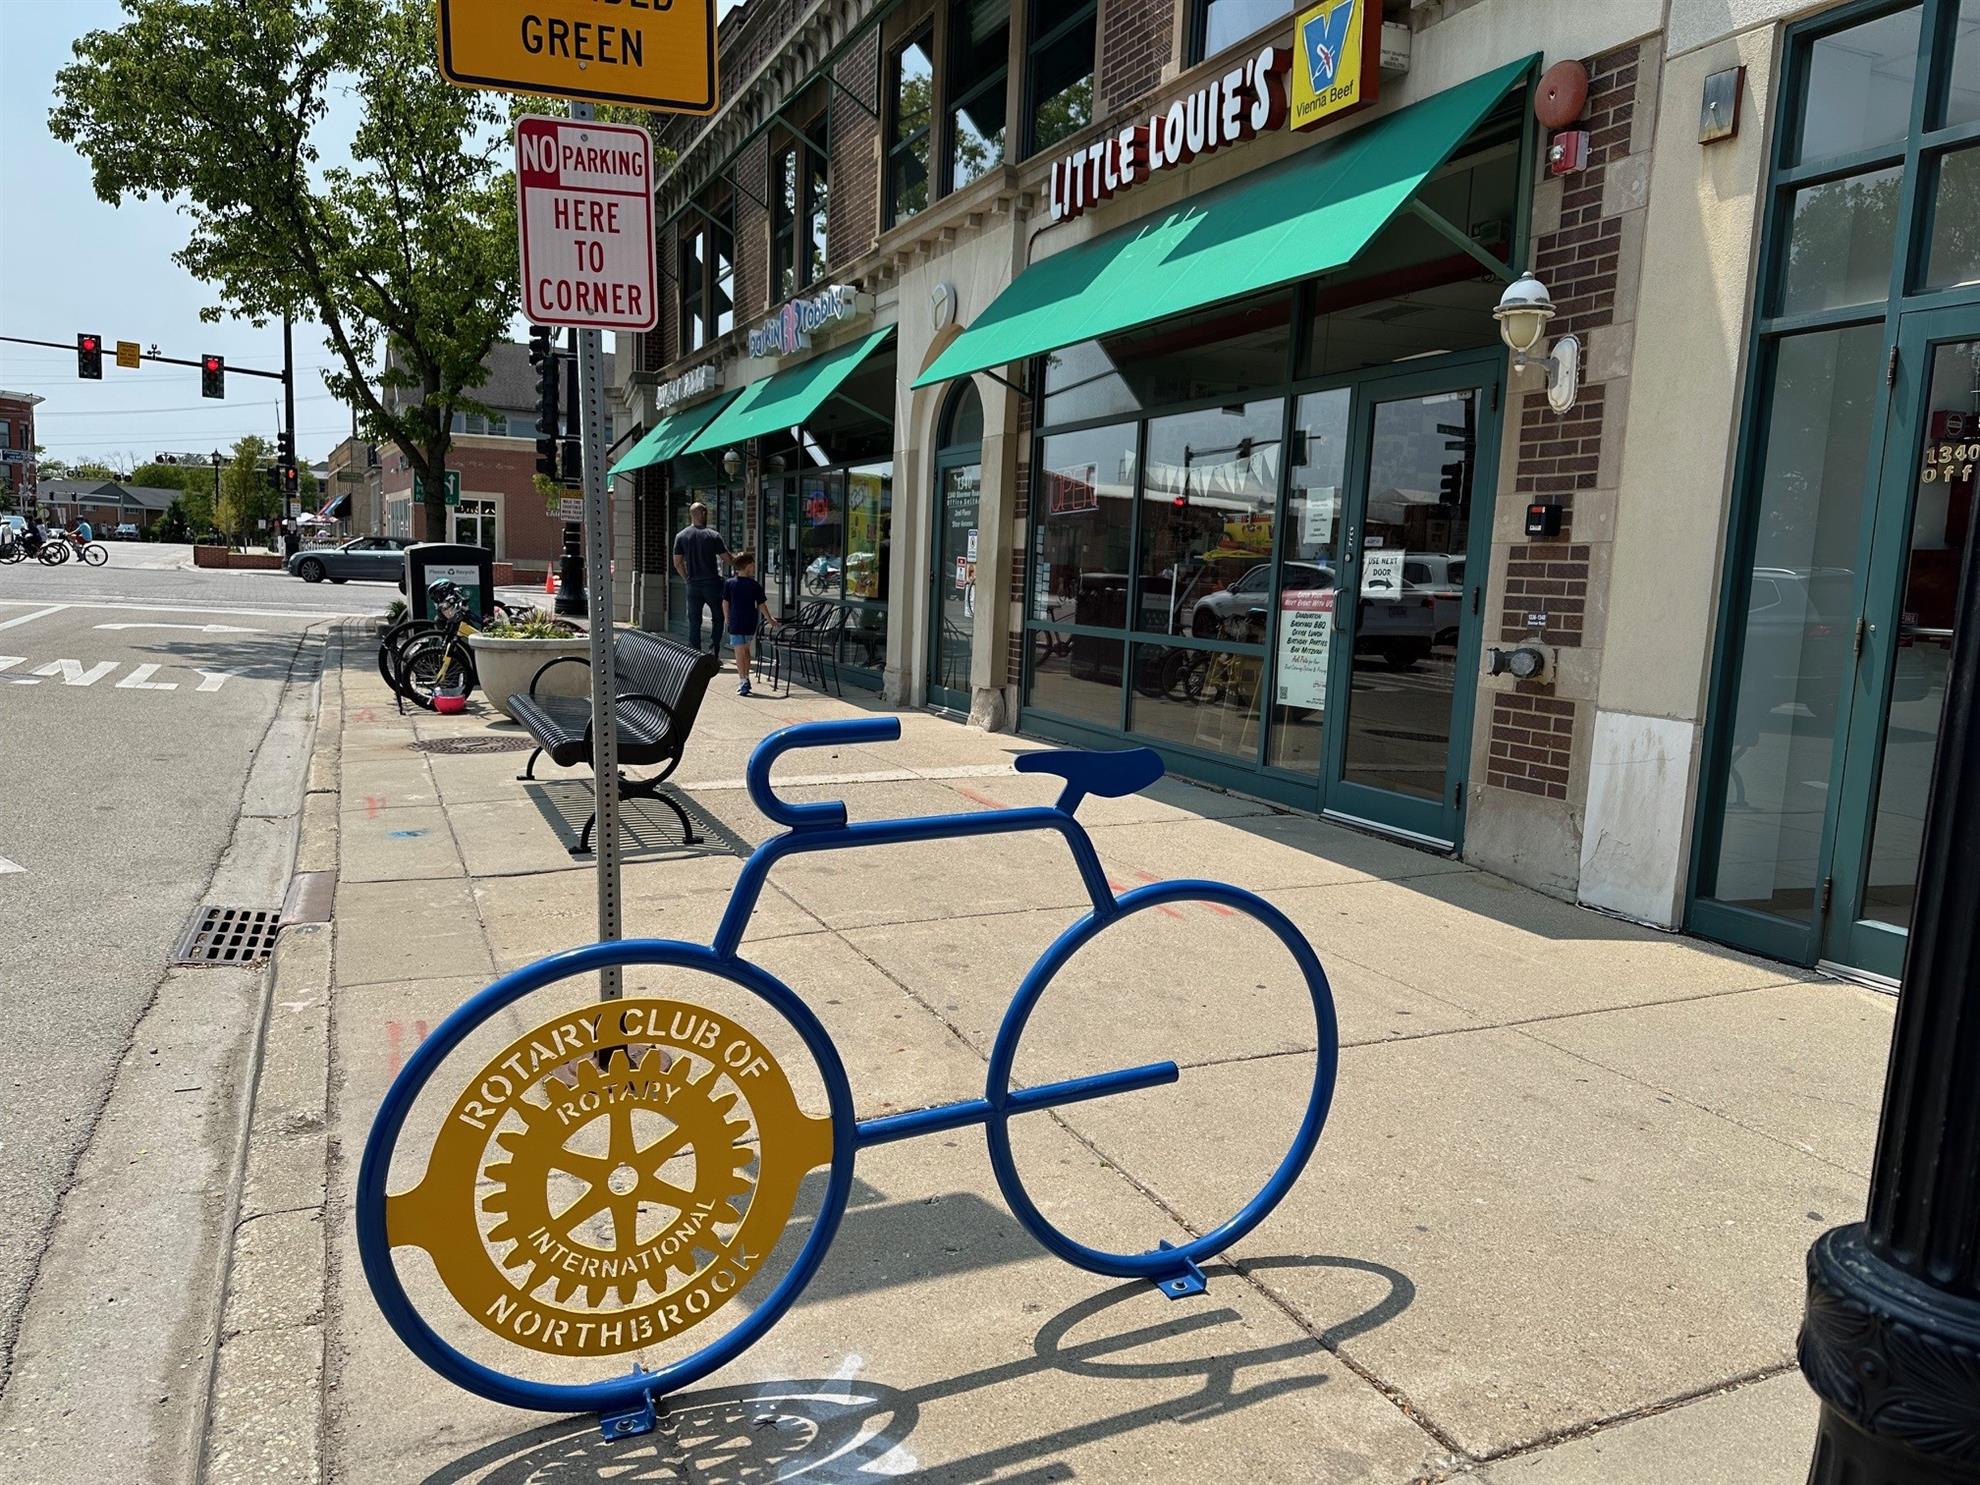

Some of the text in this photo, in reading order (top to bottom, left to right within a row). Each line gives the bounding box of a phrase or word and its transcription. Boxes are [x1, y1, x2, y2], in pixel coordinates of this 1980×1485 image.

[521, 14, 643, 67] GREEN
[1296, 79, 1355, 118] Vienna Beef
[521, 133, 643, 177] NO PARKING
[1049, 46, 1275, 222] LITTLE LOUIE'S
[554, 198, 621, 234] HERE
[574, 240, 604, 273] TO
[539, 278, 643, 316] CORNER
[1926, 443, 1980, 464] 1340
[1050, 466, 1098, 512] OPEN
[1373, 568, 1391, 576] DOOR
[1313, 620, 1326, 630] BBQ
[459, 1008, 770, 1130] ROTARY CLUB OF
[554, 1079, 682, 1127] ROTARY
[527, 1197, 717, 1279] INTERNATIONAL
[485, 1243, 760, 1350] NORTHBROOK
